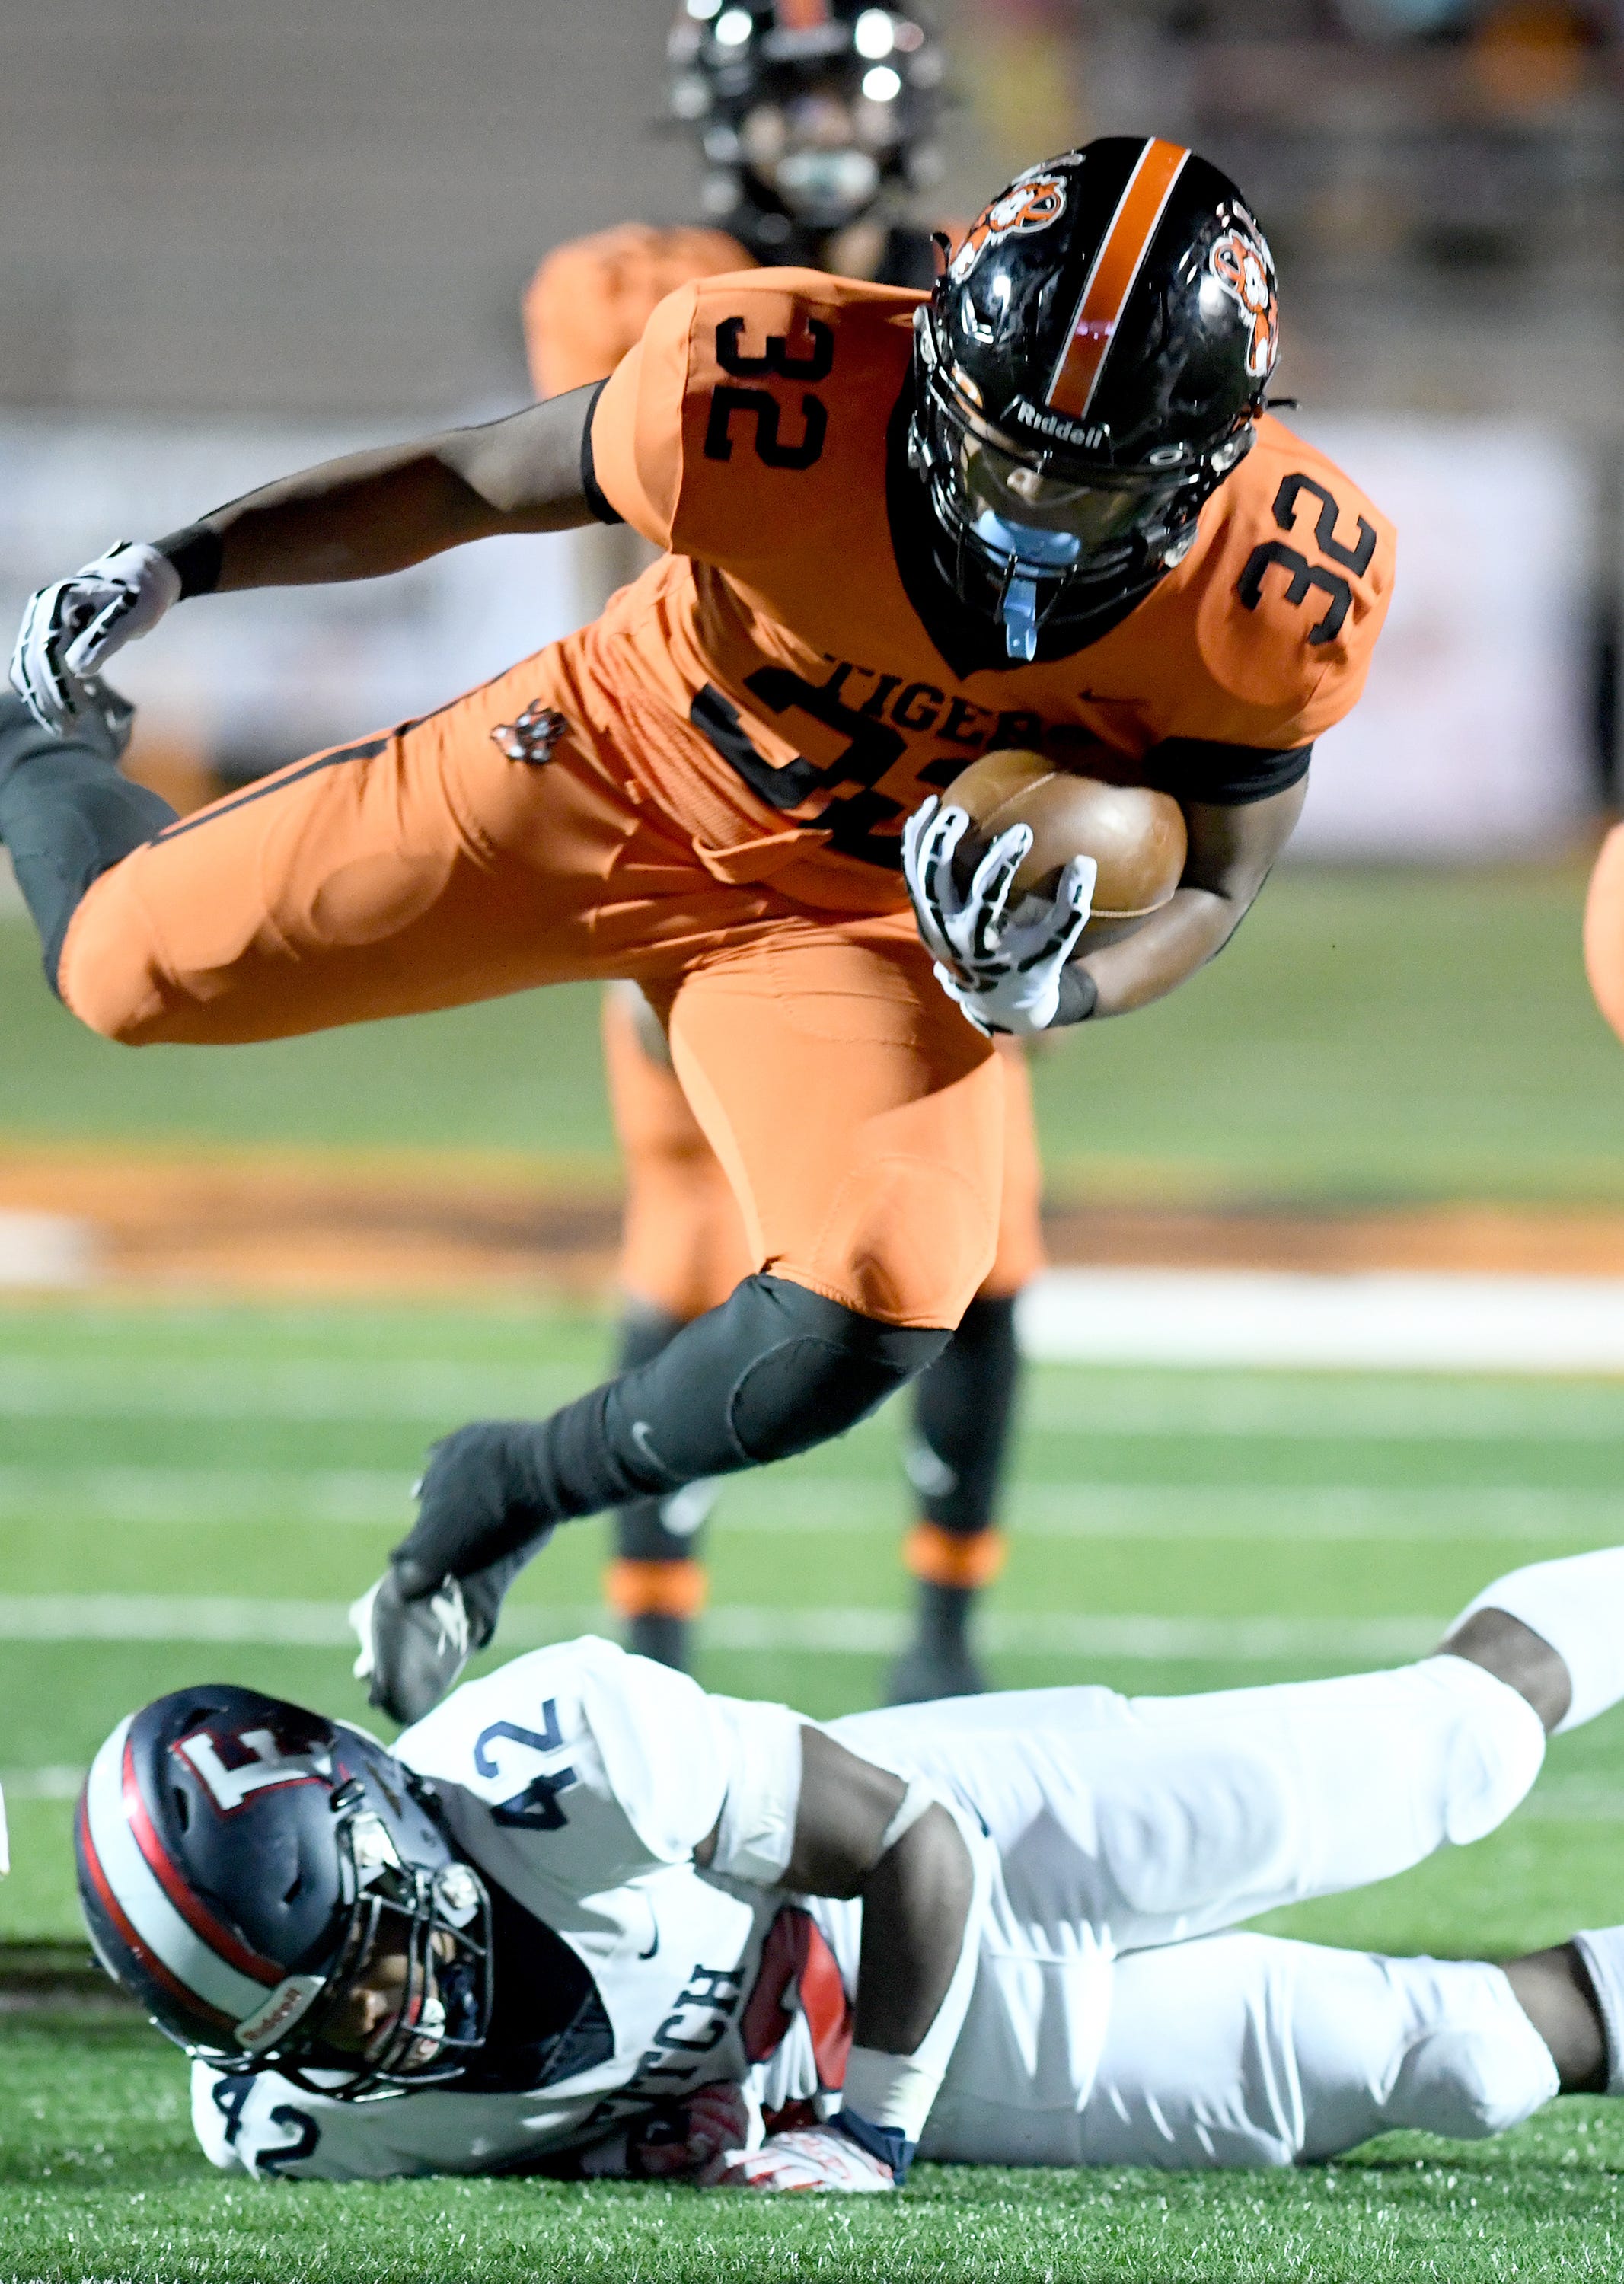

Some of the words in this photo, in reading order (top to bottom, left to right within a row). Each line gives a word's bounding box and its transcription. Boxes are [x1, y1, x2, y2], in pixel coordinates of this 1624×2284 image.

[704, 314, 834, 471] 32
[1017, 400, 1103, 449] Riddell
[1237, 472, 1377, 646] 32
[474, 1698, 578, 1831] 42
[212, 2074, 321, 2177] 42
